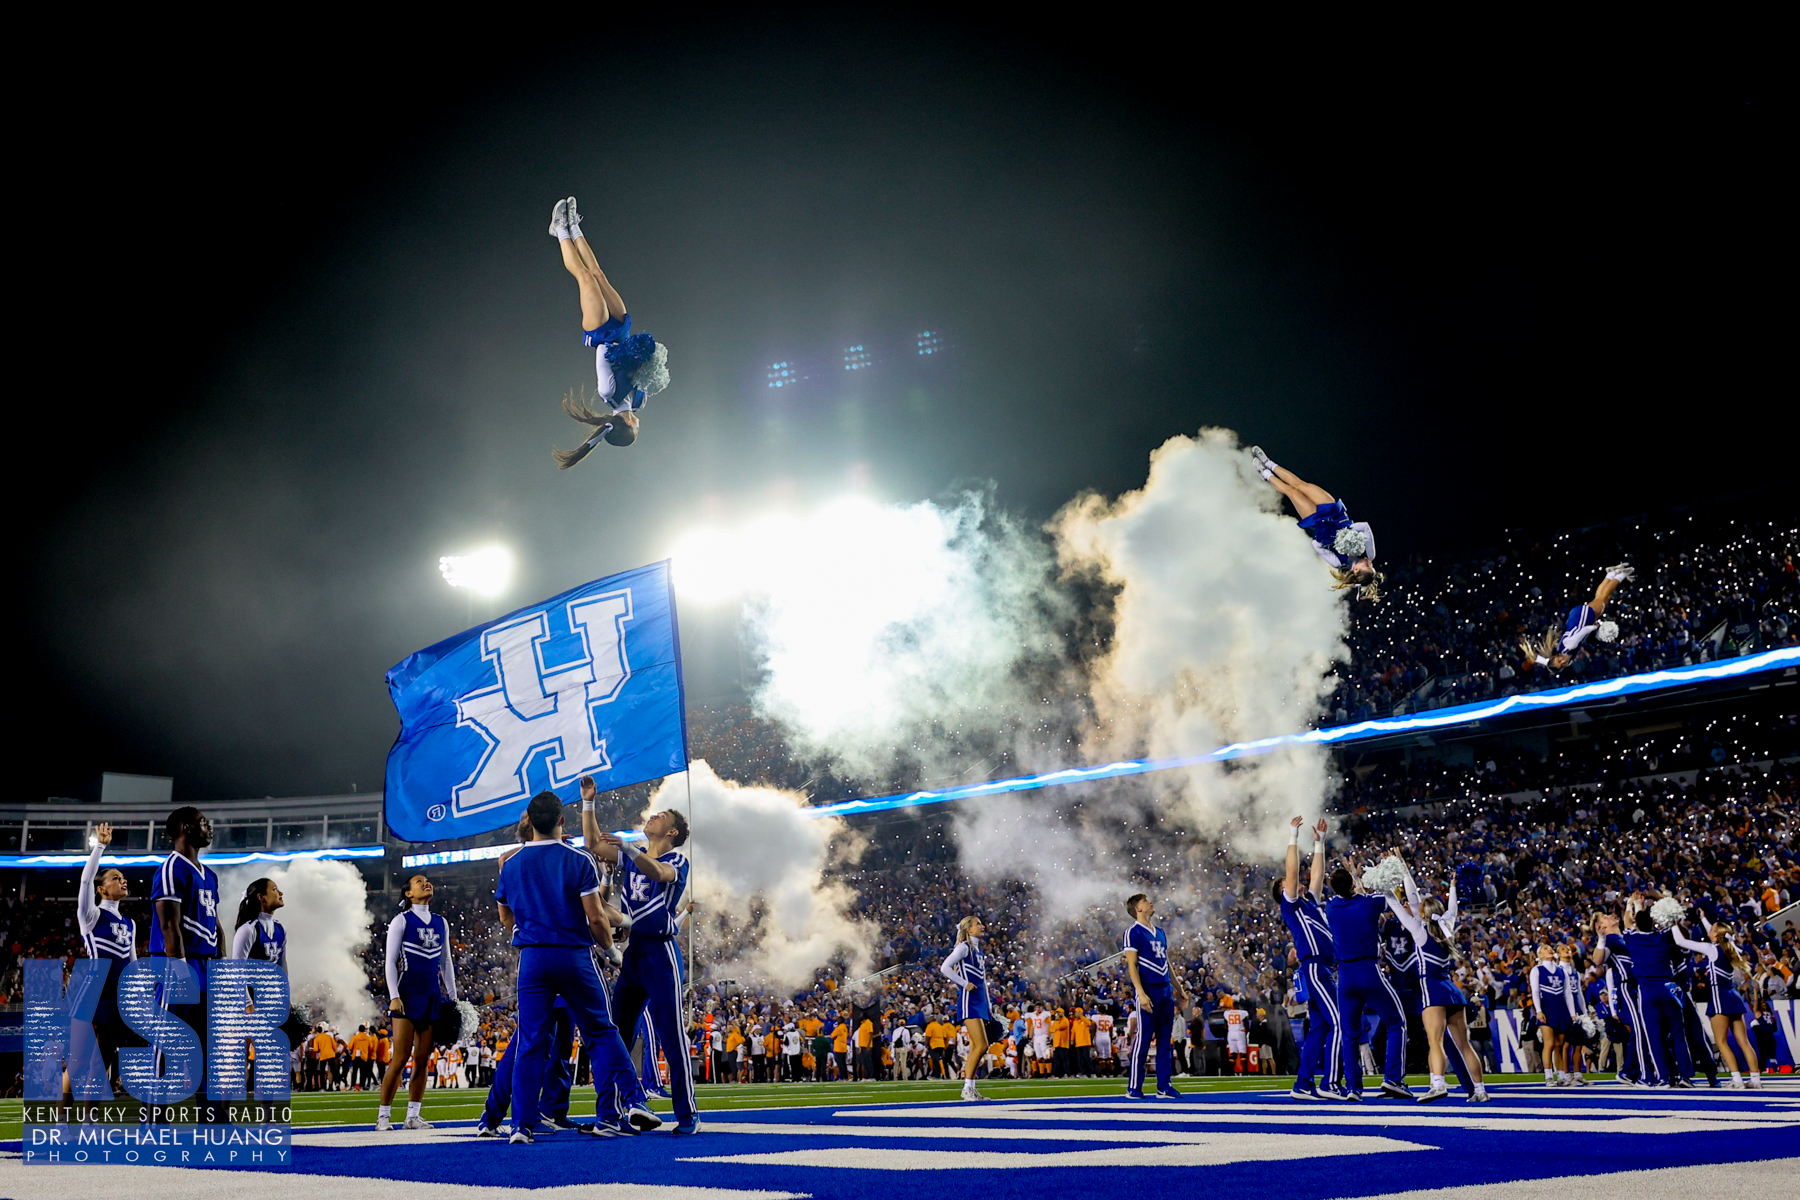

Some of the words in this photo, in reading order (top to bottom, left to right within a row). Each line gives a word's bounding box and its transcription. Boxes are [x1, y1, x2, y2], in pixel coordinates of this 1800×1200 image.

[630, 871, 651, 902] UK
[198, 888, 217, 917] UK
[109, 922, 132, 946] UK
[416, 927, 441, 948] UK
[1149, 940, 1166, 959] UK
